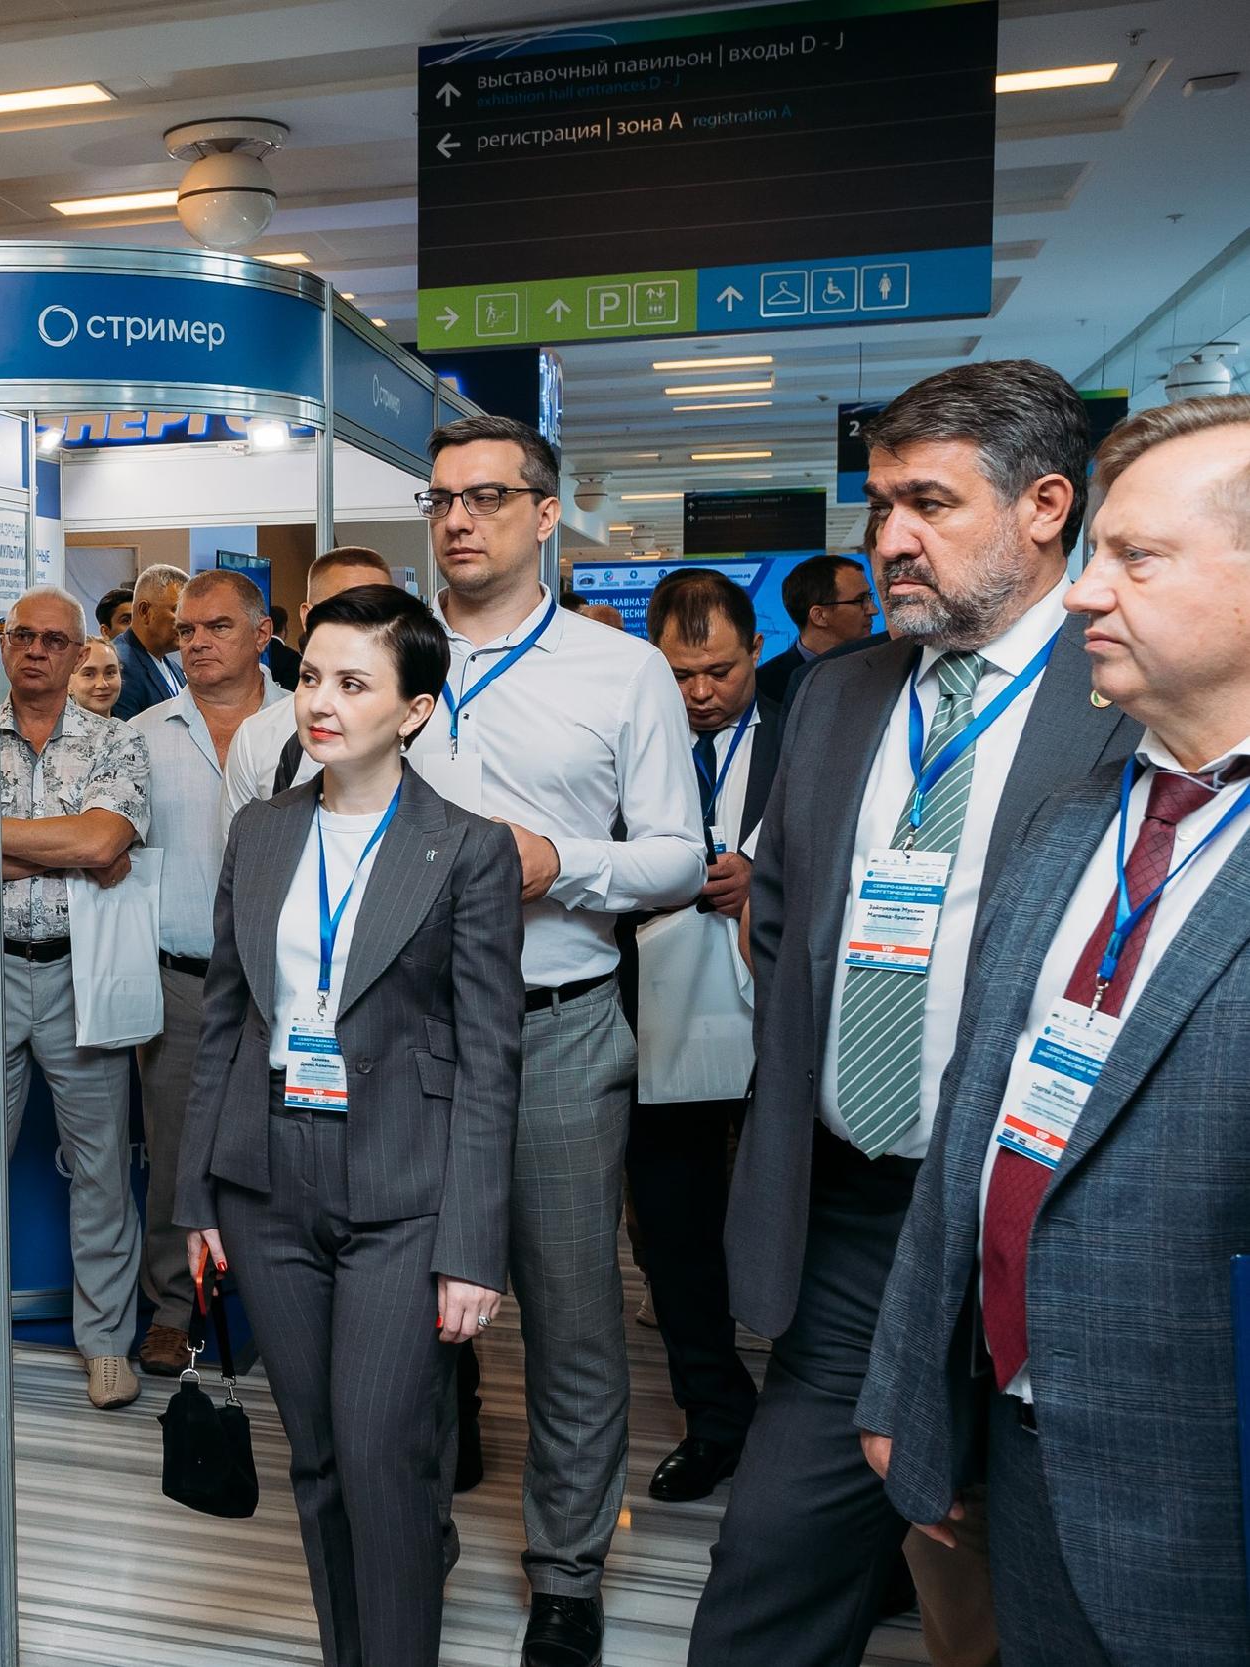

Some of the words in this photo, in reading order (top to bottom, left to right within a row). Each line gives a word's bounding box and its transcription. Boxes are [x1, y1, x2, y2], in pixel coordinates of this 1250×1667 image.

[477, 59, 608, 89] выставочный
[614, 51, 712, 75] павильон
[728, 42, 794, 63] входы
[801, 35, 816, 54] D
[834, 31, 844, 51] J
[477, 89, 546, 108] exhibition
[577, 80, 648, 98] entrances
[692, 107, 778, 128] registration
[781, 103, 793, 118] A
[477, 122, 602, 152] регистрация
[616, 117, 663, 136] зона
[86, 315, 226, 352] стример
[880, 944, 897, 953] VIP
